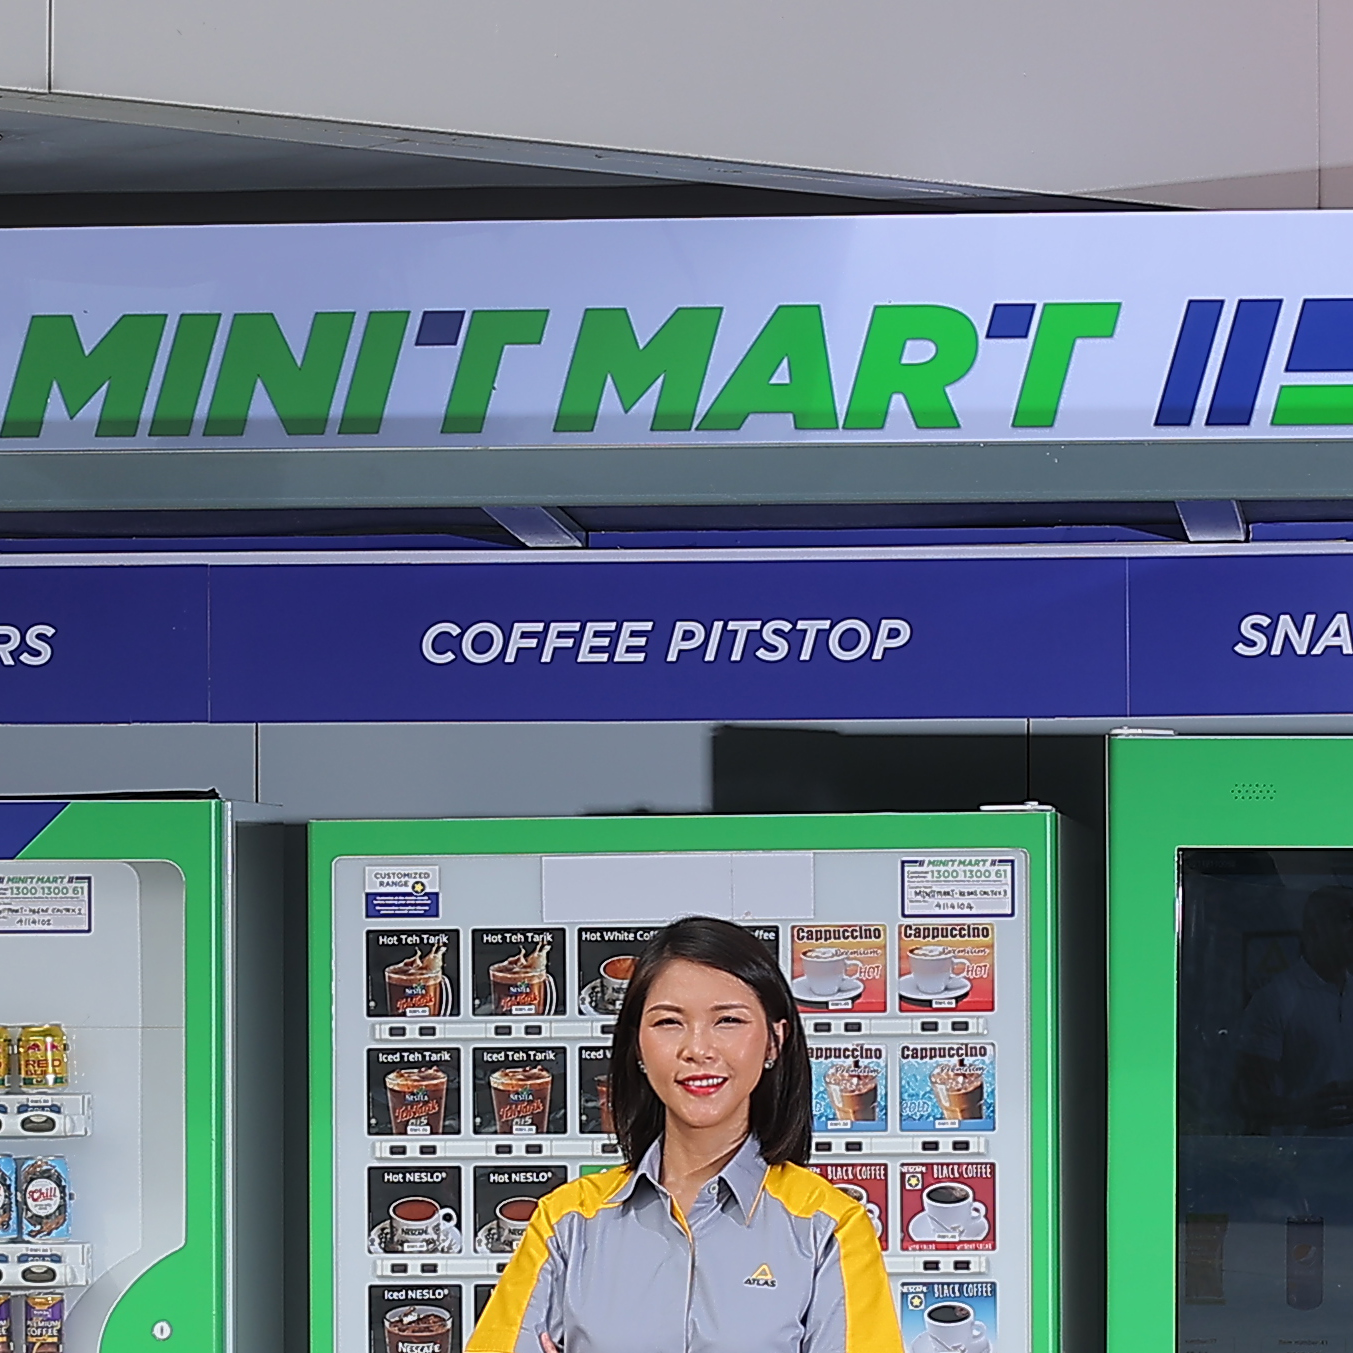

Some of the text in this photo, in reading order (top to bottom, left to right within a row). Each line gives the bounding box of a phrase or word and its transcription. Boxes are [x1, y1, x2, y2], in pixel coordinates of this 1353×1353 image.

[0, 301, 1123, 439] MINIT MART
[420, 618, 912, 664] COFFEE PITSTOP
[926, 859, 989, 867] MINIT MART
[374, 872, 431, 880] CUSTOMIZED
[931, 869, 1007, 879] 1300 1300 61
[35, 875, 66, 884] MART
[379, 880, 410, 888] RANGE
[10, 886, 37, 896] 1300
[41, 886, 69, 896] 1300
[72, 886, 85, 896] 61
[582, 931, 634, 941] Hot White
[797, 926, 882, 942] Cappuccino
[903, 924, 990, 940] Cappuccino
[379, 933, 448, 945] Hot Teh Tarik
[483, 932, 553, 943] Hot Teh Tarik
[858, 965, 882, 979] HOT
[965, 964, 990, 979] HOT
[379, 1051, 451, 1062] Iced Teh Tarik
[483, 1051, 555, 1061] Iced Teh Tarik
[582, 1049, 603, 1059] Iced
[901, 1045, 988, 1060] Cappuccino
[827, 1166, 885, 1179] BLACK COFFEE
[933, 1164, 992, 1178] BLACK COFFEE
[384, 1172, 403, 1182] Hot
[490, 1172, 509, 1182] Hot
[744, 1277, 777, 1287] ATLAS
[384, 1290, 406, 1299] Iced
[934, 1283, 992, 1298] BLACK COFFEE
